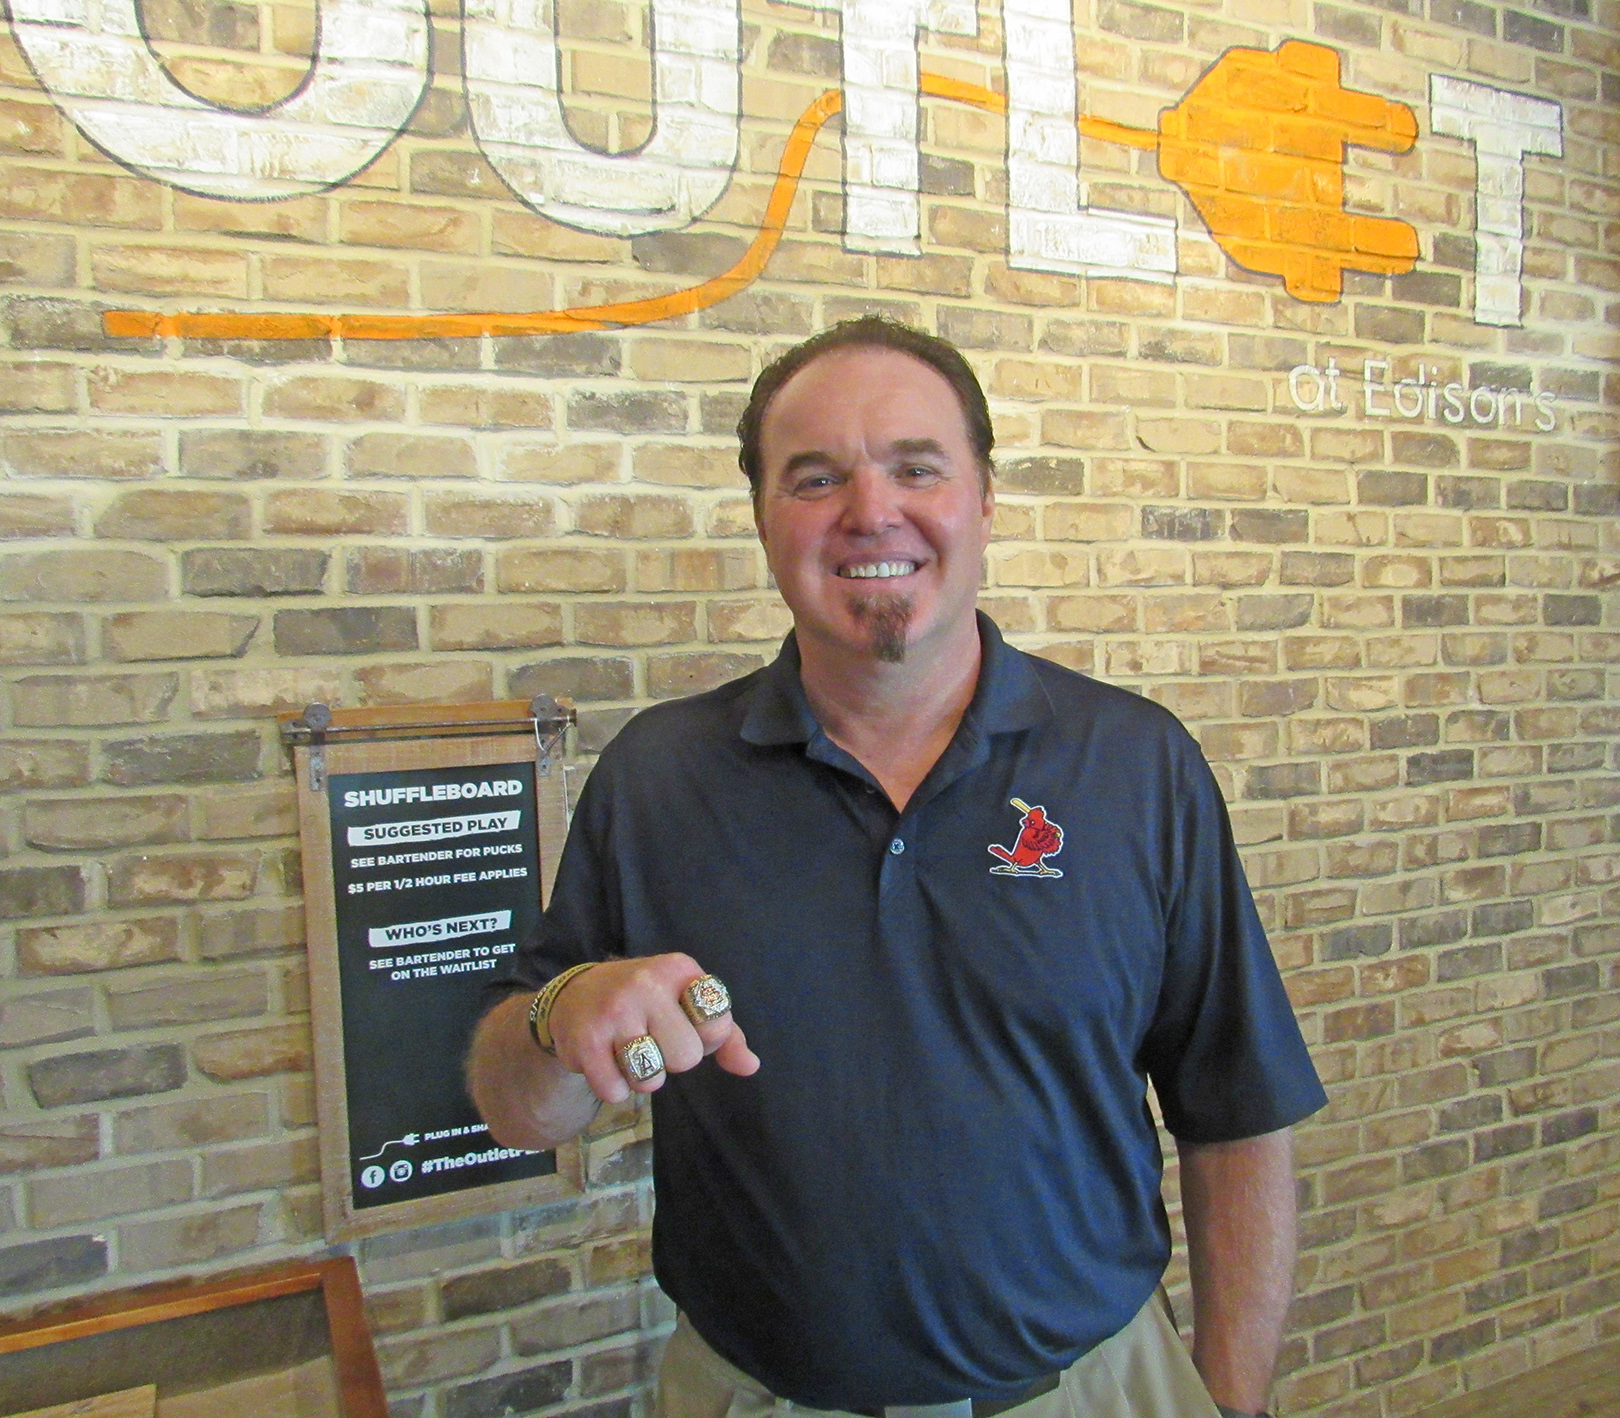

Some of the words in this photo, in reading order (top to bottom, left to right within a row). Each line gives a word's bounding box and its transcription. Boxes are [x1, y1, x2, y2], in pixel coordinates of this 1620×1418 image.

[1288, 357, 1343, 411] at
[344, 780, 523, 807] SHUFFLEBOARD
[364, 821, 463, 840] SUGGESTED
[468, 817, 508, 832] PLAY
[351, 858, 376, 869] SEE
[378, 850, 453, 866] BARTENDER
[455, 848, 482, 859] FOR
[483, 844, 523, 856] PUCKS
[347, 882, 364, 895] $5
[366, 880, 392, 892] PER
[394, 878, 413, 891] 1/2
[415, 874, 451, 887] HOUR
[453, 872, 477, 883] FEE
[478, 867, 528, 881] APPLIES
[385, 924, 442, 941] WHO'S
[446, 917, 498, 934] NEXT?
[369, 958, 394, 970] SEE
[396, 950, 471, 967] BARTENDER
[472, 947, 490, 957] TO
[492, 943, 516, 955] GET
[391, 970, 411, 981] ON
[412, 966, 438, 978] THE
[439, 959, 497, 975] WAITLIST
[424, 1129, 450, 1141] PLUG
[451, 1127, 462, 1137] IN
[463, 1126, 470, 1135] &
